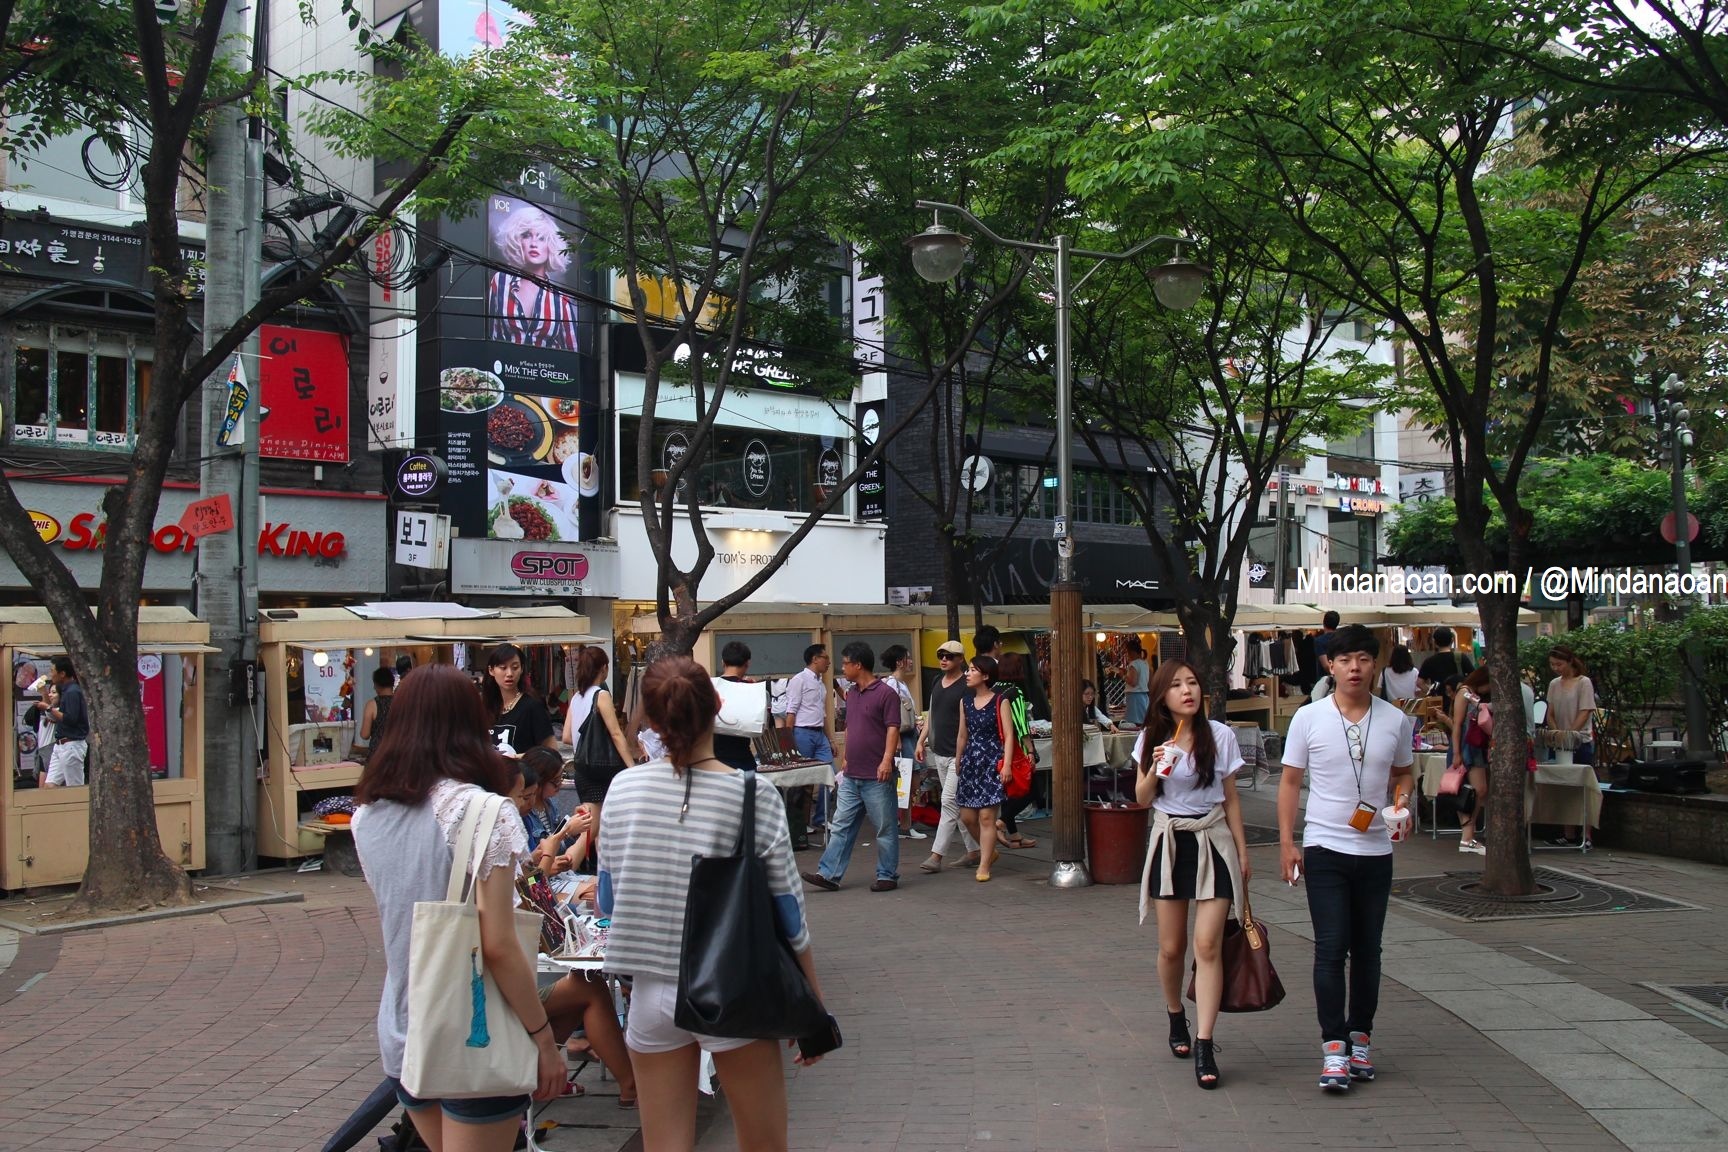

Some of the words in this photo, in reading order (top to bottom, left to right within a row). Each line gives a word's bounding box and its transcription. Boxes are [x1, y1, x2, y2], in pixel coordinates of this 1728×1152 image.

[494, 199, 510, 212] VOG
[61, 229, 100, 241] 가맹점문의
[102, 234, 142, 246] 3144-1525
[860, 351, 878, 361] 3F
[504, 363, 520, 375] MIX
[522, 367, 538, 377] THE
[540, 369, 569, 380] GREEN
[409, 463, 427, 471] Coffee
[866, 470, 878, 478] THE
[859, 483, 880, 491] GREEN
[400, 516, 427, 547] 보그
[1057, 522, 1063, 532] 3
[258, 523, 345, 557] KING
[408, 553, 417, 562] 3F
[717, 551, 746, 565] TOM'S
[750, 554, 791, 566] PROJT
[512, 556, 586, 576] SPOT
[319, 666, 333, 678] 5.0
